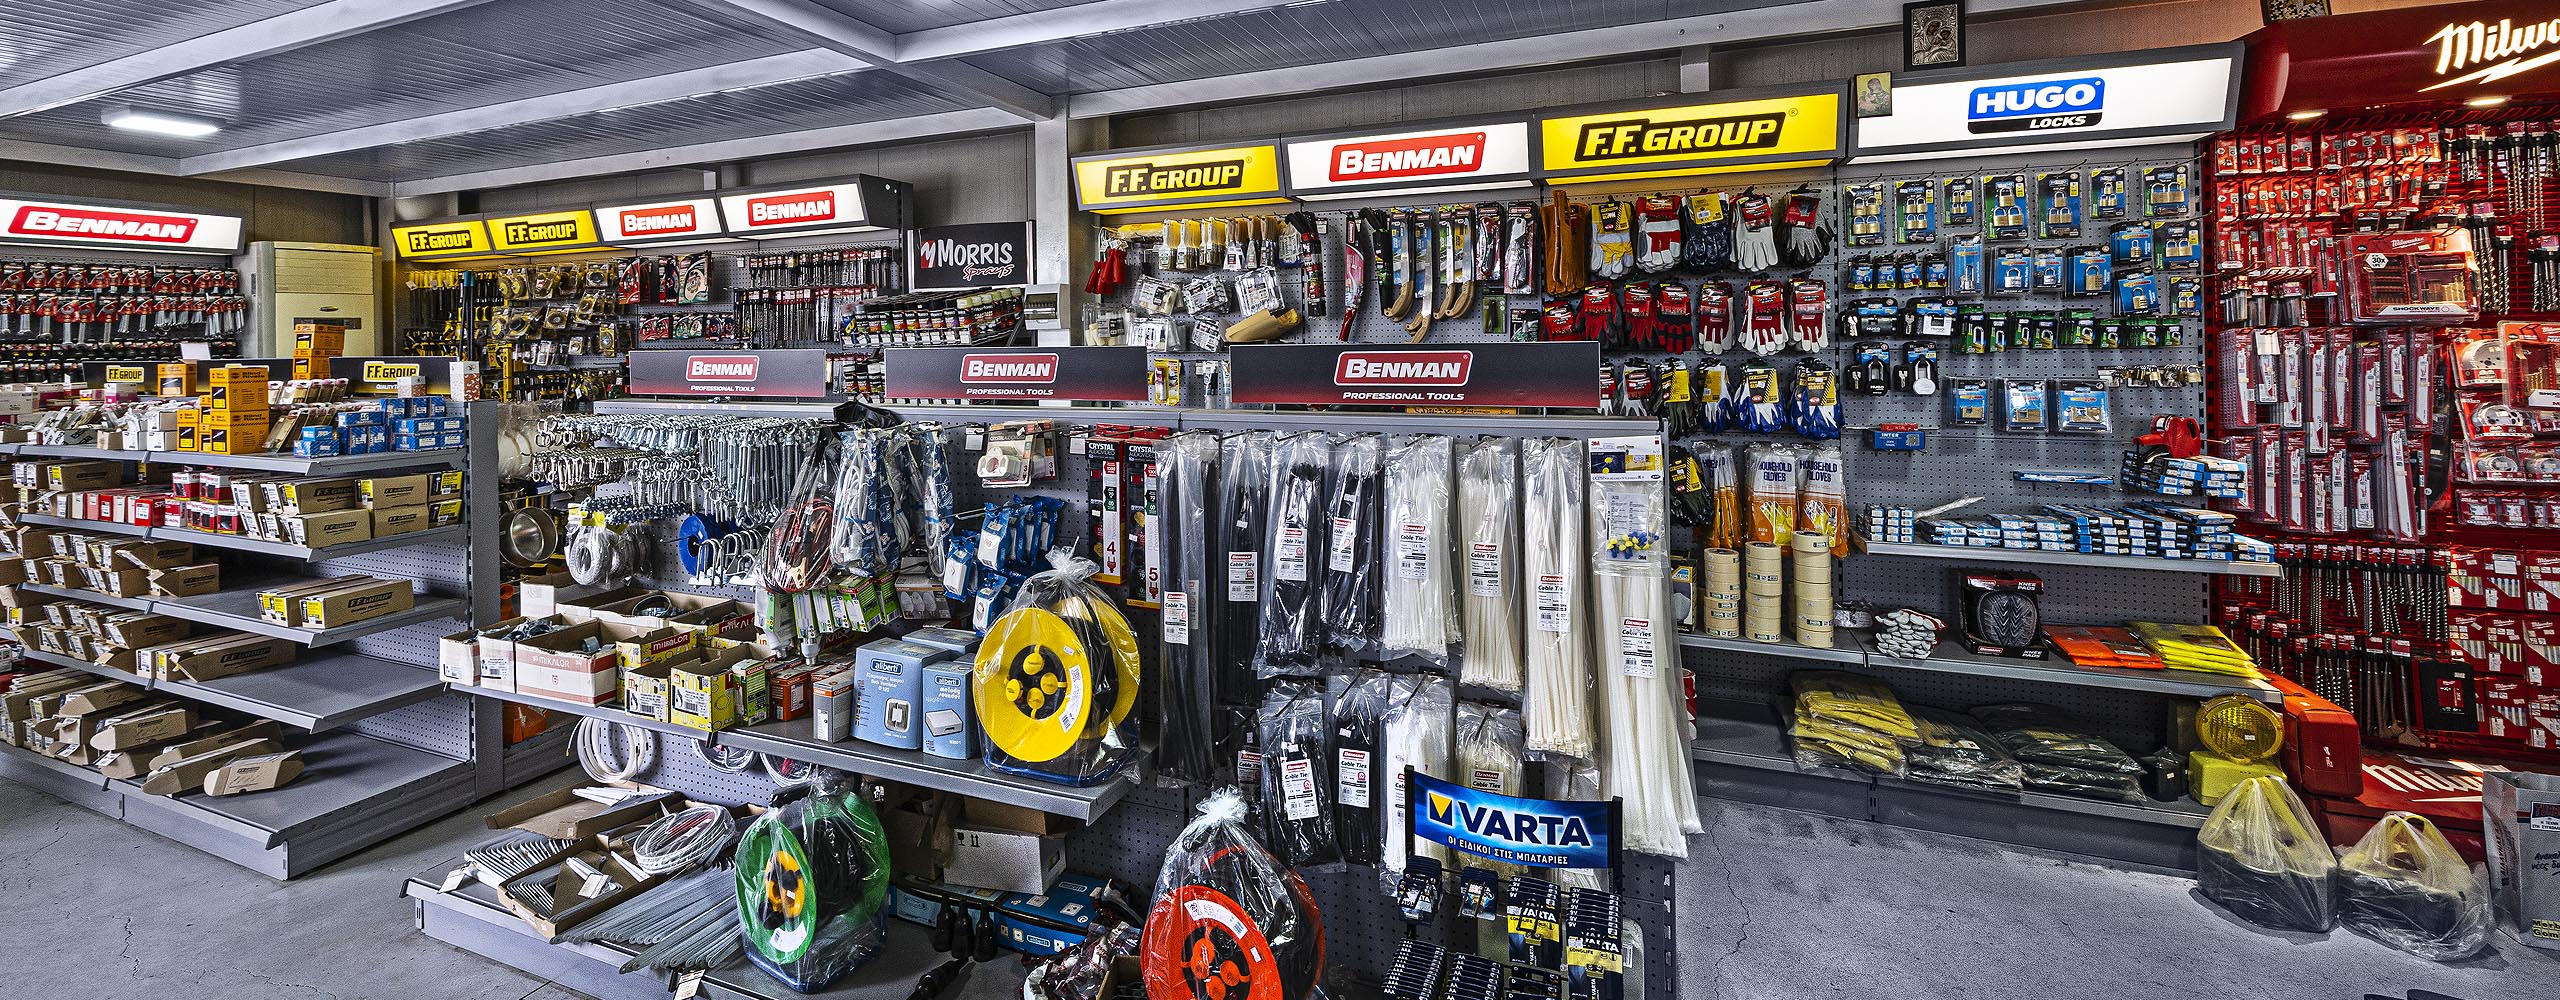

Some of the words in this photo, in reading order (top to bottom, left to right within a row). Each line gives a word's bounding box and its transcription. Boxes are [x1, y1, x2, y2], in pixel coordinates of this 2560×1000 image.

[1976, 85, 2098, 114] HUGO
[2029, 115, 2088, 129] LOCKS
[1338, 145, 1476, 175] BENMAN
[752, 198, 831, 221] BENMAN
[24, 210, 188, 240] BENMAN
[623, 212, 693, 232] BENMAN
[2391, 236, 2425, 248] Milwaukee
[937, 238, 1013, 267] MORRIS
[963, 263, 1015, 282] Sprays
[692, 358, 754, 378] BENMAN
[968, 360, 1050, 377] BENMAN
[1344, 358, 1460, 379] BENMAN
[691, 384, 734, 392] PROFESSIONAL
[735, 385, 755, 393] TOOLS
[1026, 388, 1054, 396] TOOLS
[1342, 391, 1424, 401] PROFESSIONAL
[1427, 391, 1465, 401] TOOLS
[1088, 442, 1115, 451] CRYSTAL
[1106, 541, 1116, 554] 4
[1148, 567, 1158, 581] 5
[875, 662, 898, 672] aliberti
[1458, 801, 1591, 847] VARTA
[1448, 835, 1457, 845] ΟΙ
[1459, 840, 1491, 854] ΕΙΔΙΚΟΙ
[1494, 848, 1513, 859] ΣΤΙΣ
[1516, 852, 1568, 864] ΜΠΑΤΑΡΙΕΣ
